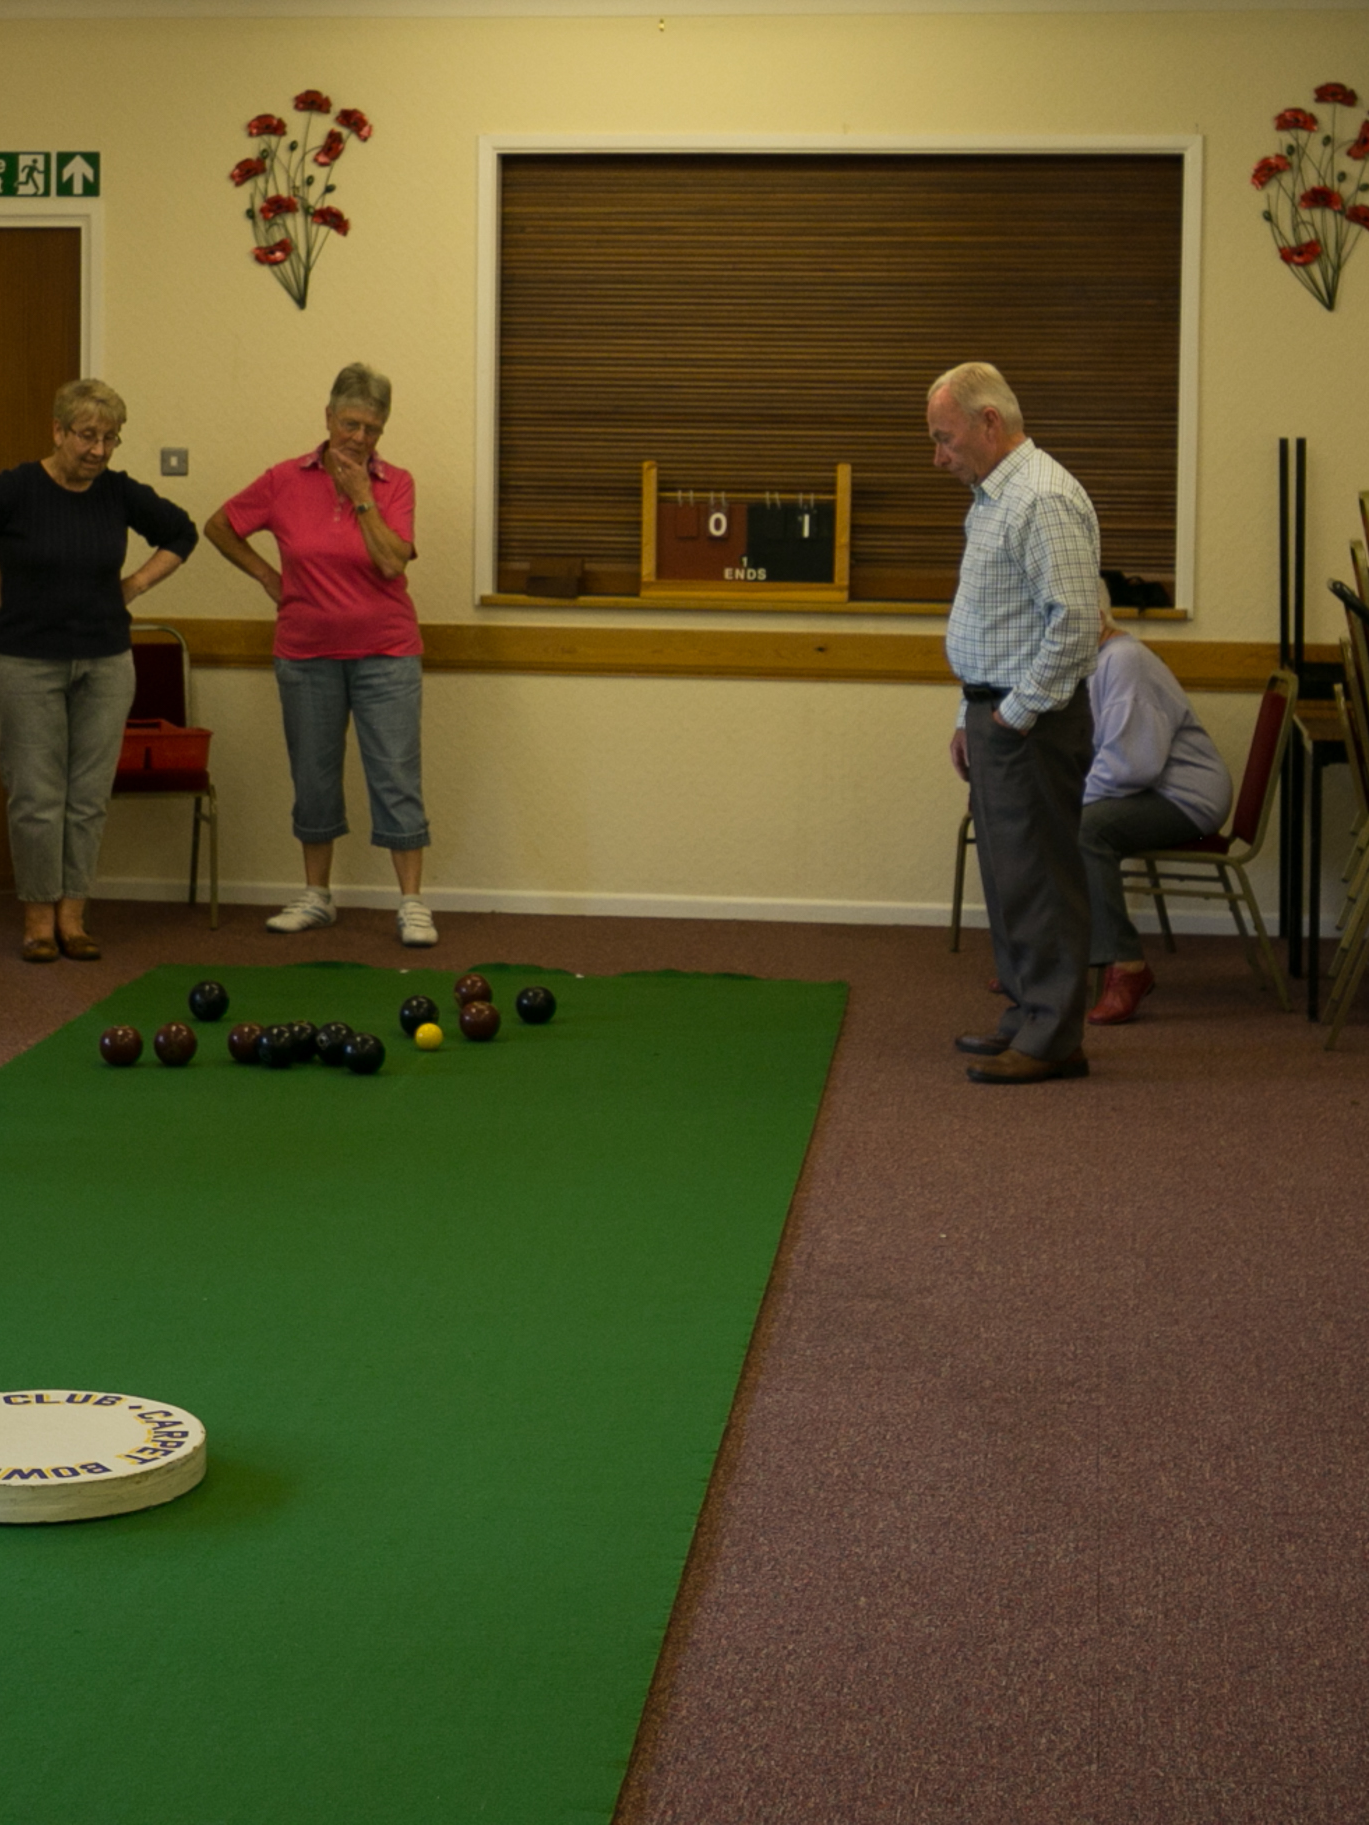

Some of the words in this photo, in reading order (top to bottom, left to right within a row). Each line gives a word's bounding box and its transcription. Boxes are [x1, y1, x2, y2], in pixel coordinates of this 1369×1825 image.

[708, 512, 728, 536] 0
[724, 567, 767, 580] ENDS
[3, 1393, 125, 1406] CLUB
[125, 1410, 190, 1465] CARPET
